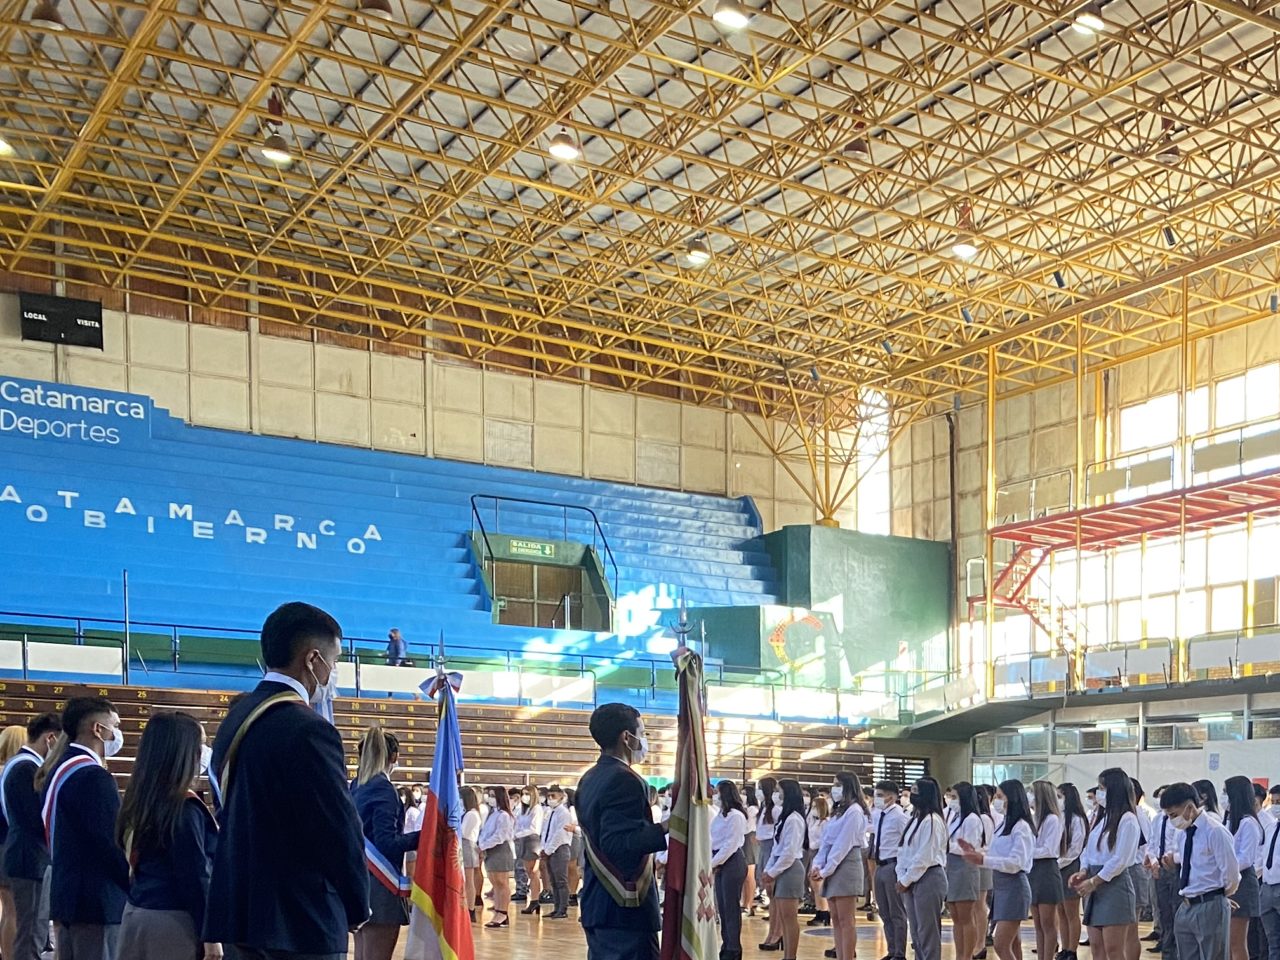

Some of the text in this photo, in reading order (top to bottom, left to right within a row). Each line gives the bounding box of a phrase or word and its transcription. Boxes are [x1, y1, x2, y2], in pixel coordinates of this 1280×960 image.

[24, 311, 47, 321] LOCAL
[76, 318, 100, 328] VISITA
[0, 381, 144, 419] Catamarca
[0, 408, 120, 445] Deportes
[511, 541, 542, 549] SALIDA
